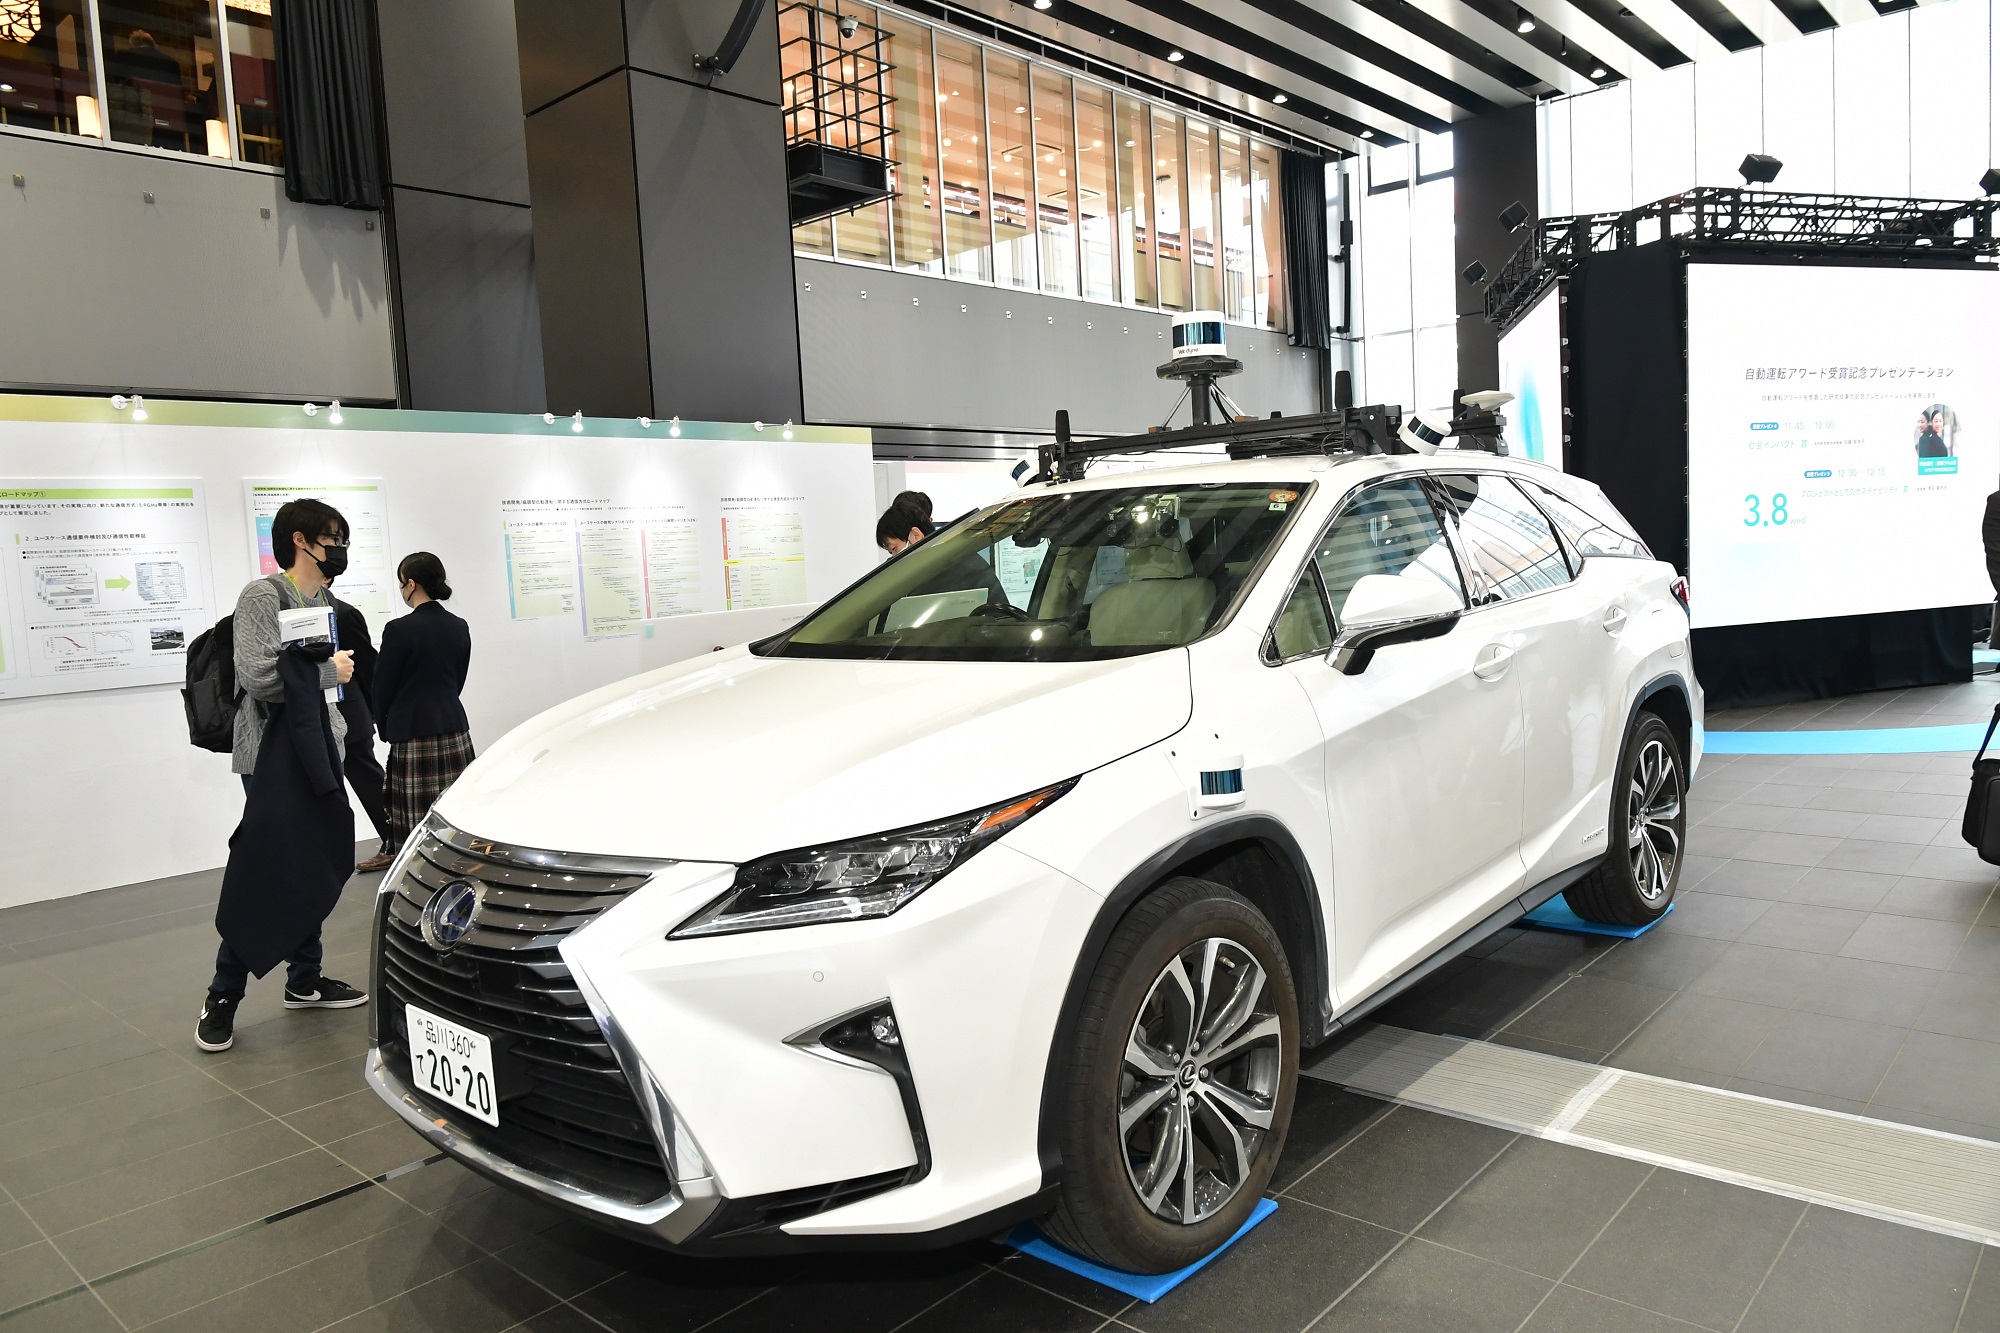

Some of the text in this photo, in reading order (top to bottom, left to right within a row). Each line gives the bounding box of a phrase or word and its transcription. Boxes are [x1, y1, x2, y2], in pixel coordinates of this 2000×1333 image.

[1745, 366, 1954, 381] 自動運転アワード受賞記念プレゼンテーション
[1744, 493, 1788, 527] 3.8
[427, 1048, 492, 1115] 20-20
